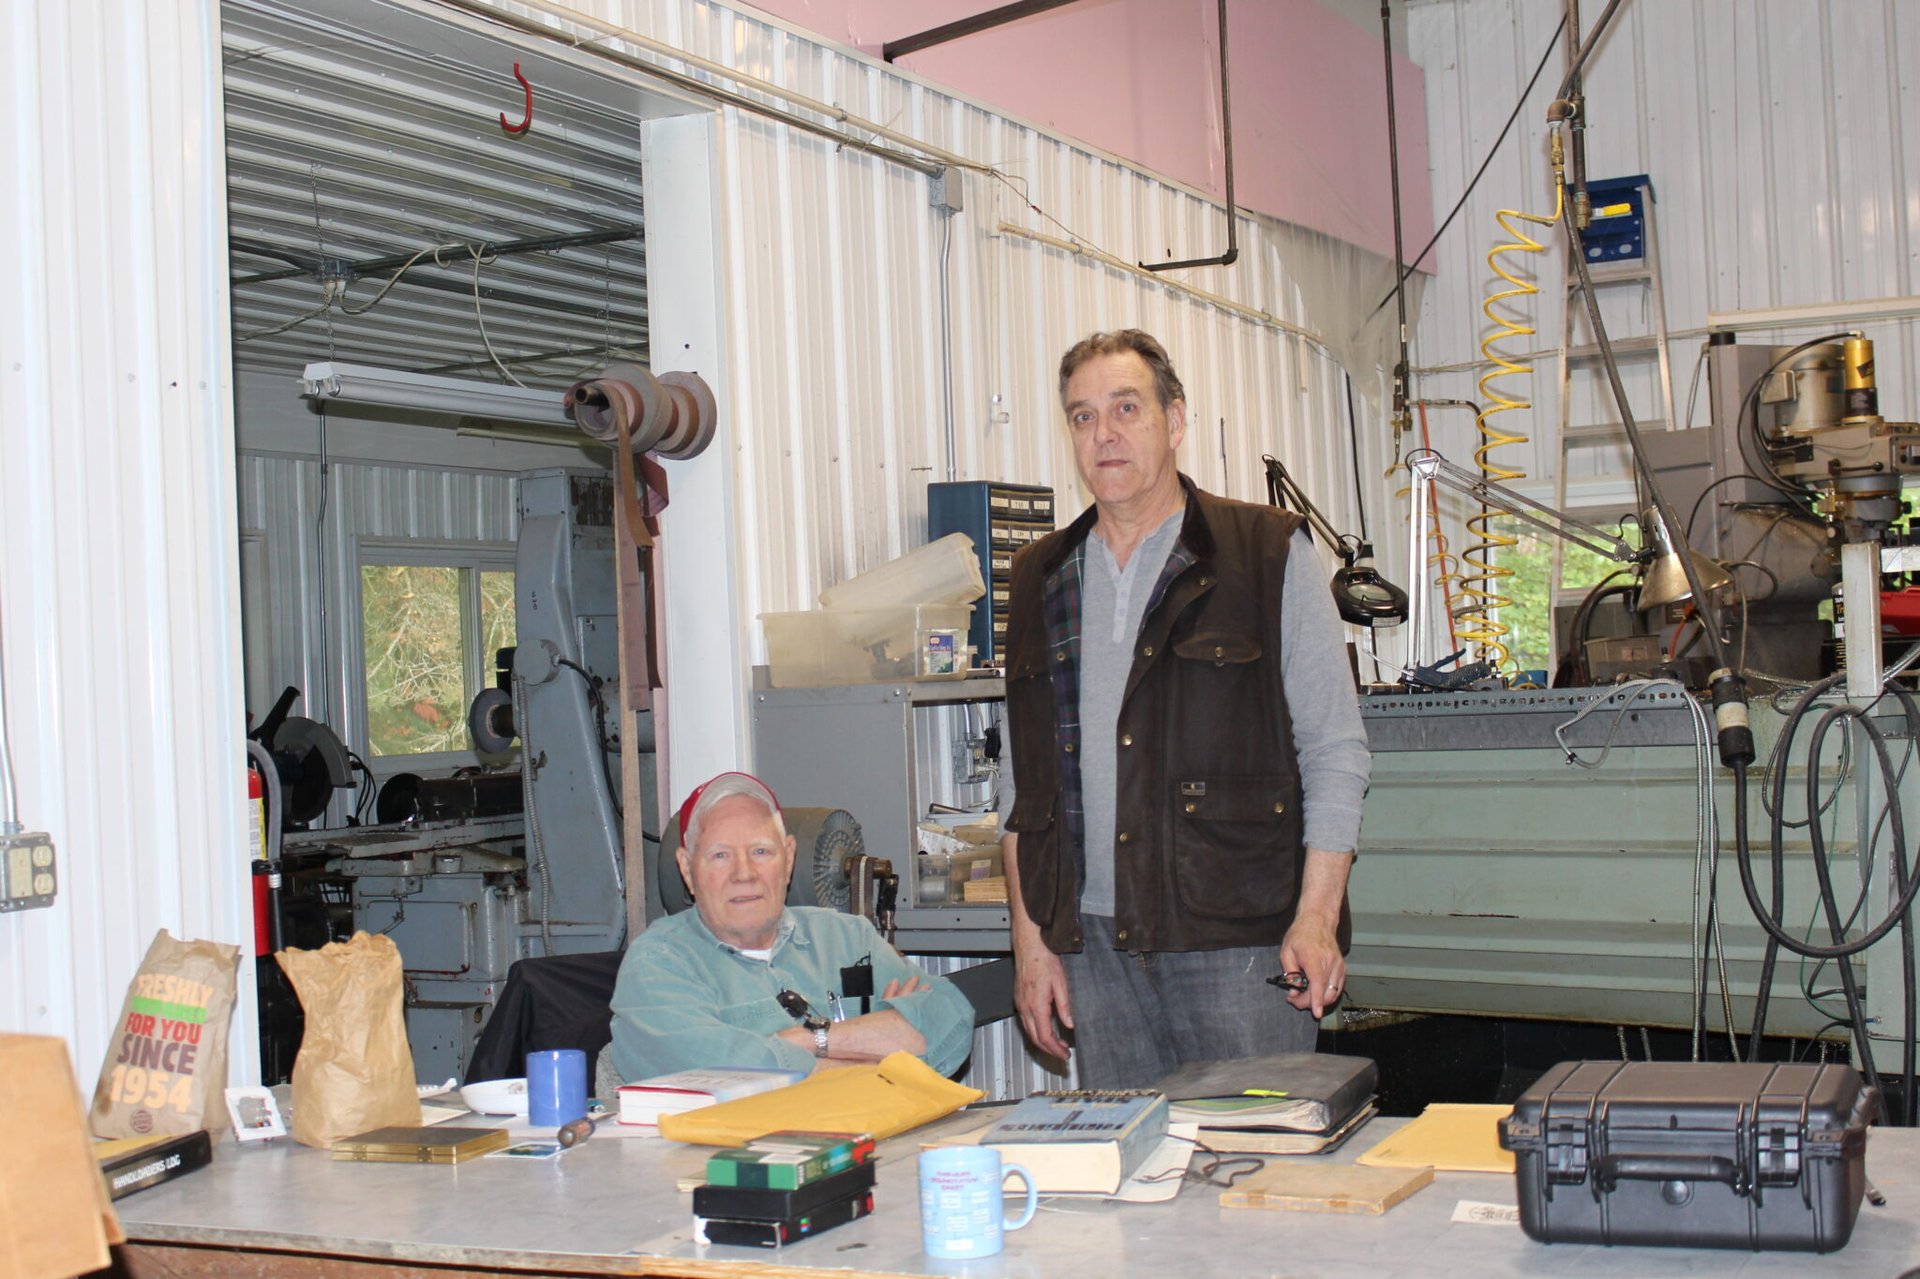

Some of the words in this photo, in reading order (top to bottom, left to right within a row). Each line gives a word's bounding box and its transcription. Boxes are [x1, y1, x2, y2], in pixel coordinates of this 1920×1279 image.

[138, 974, 213, 1007] FRESHLY
[124, 1011, 156, 1038] FOR
[161, 1018, 202, 1044] YOU
[116, 1033, 198, 1075] SINCE
[109, 1064, 193, 1113] 1954
